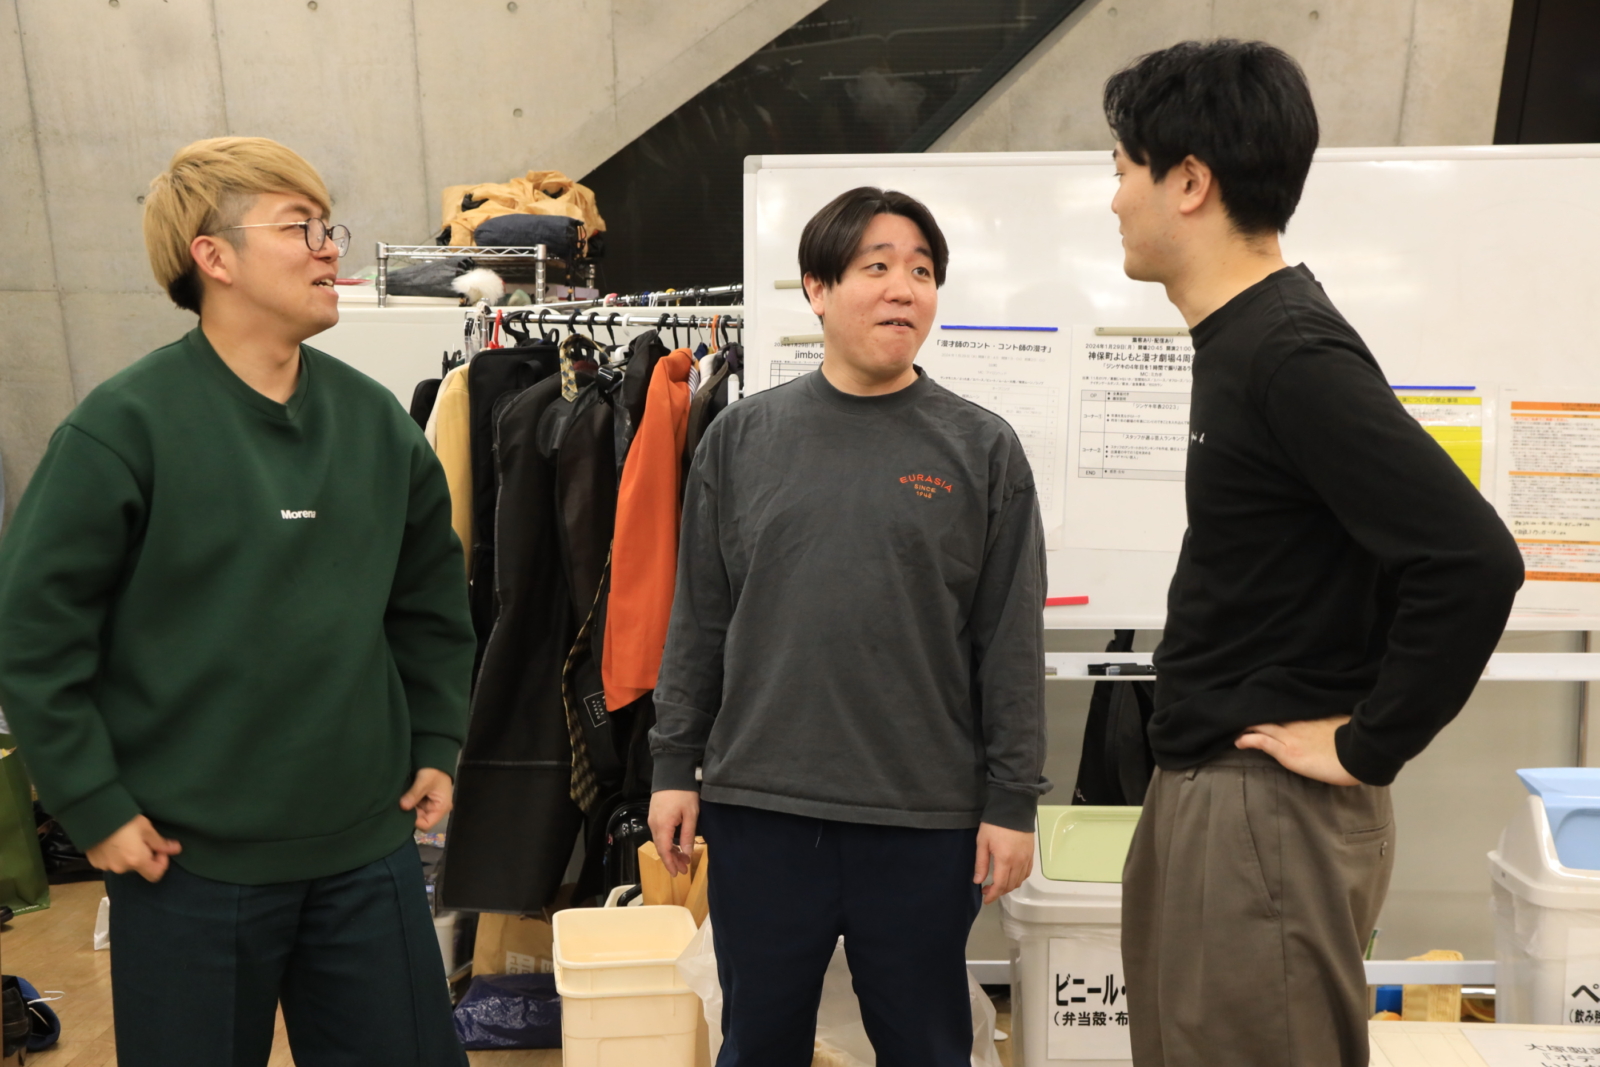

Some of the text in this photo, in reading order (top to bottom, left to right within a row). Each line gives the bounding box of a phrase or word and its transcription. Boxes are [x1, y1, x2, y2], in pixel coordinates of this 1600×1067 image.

[795, 350, 824, 359] jimboc
[899, 474, 953, 493] EURASIA
[914, 484, 937, 493] SINCE
